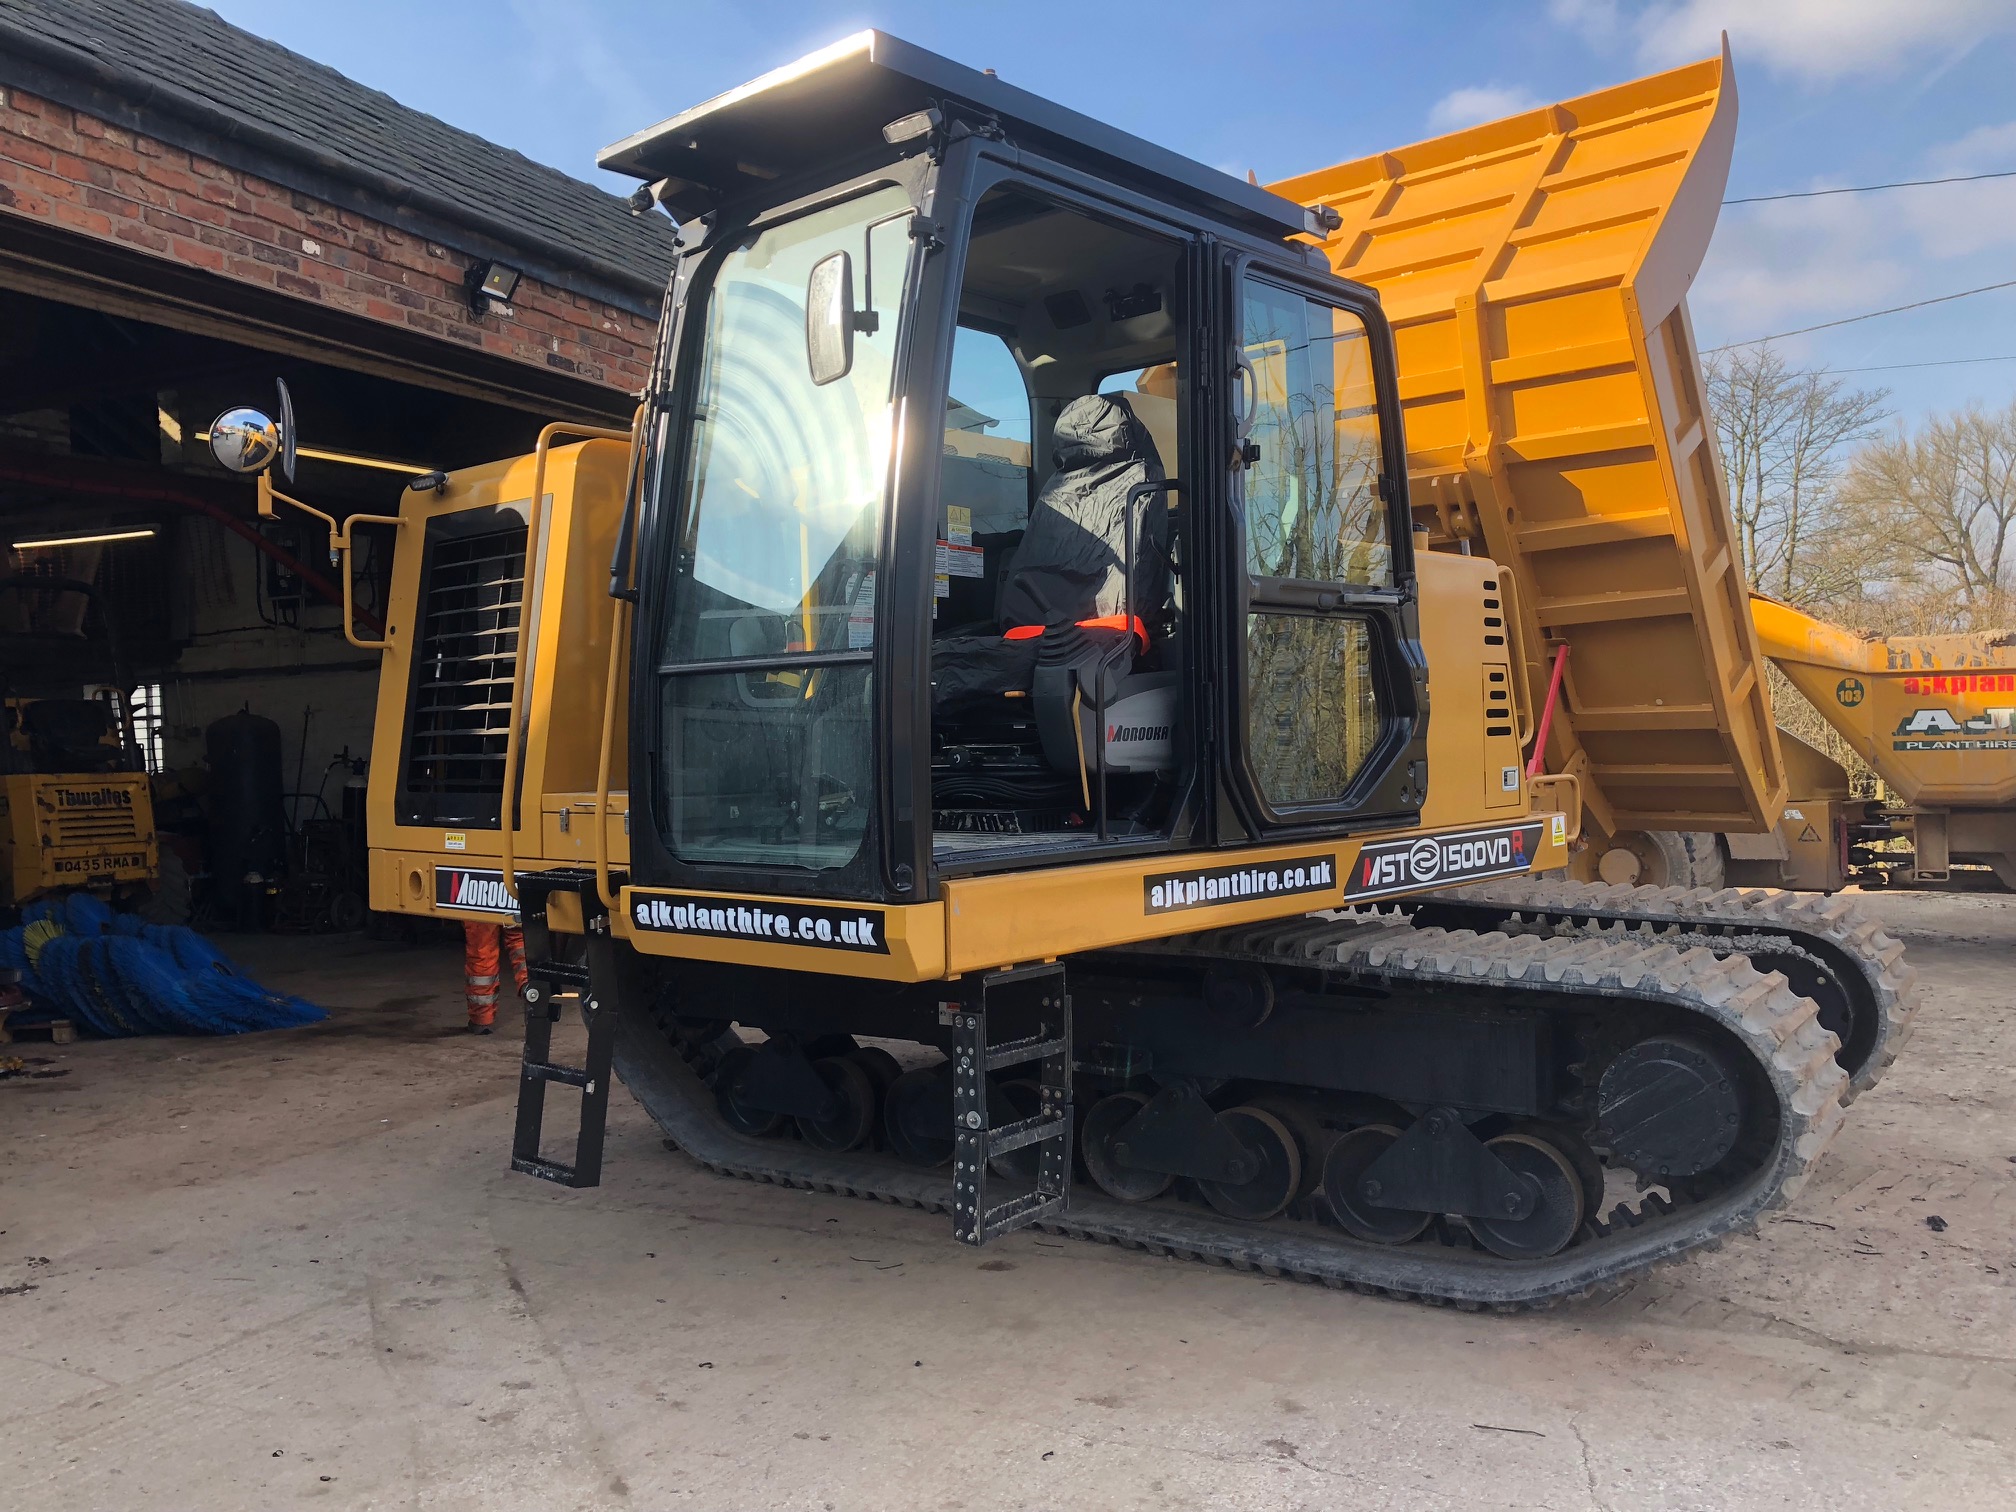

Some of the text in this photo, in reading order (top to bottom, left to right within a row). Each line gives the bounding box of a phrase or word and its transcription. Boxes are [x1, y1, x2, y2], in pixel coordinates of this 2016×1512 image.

[55, 788, 131, 806] Thwaites
[103, 857, 129, 869] RMA
[1151, 861, 1331, 908] ajkplanthire.co.uk
[636, 900, 878, 946] ajkplanthire.co.uk
